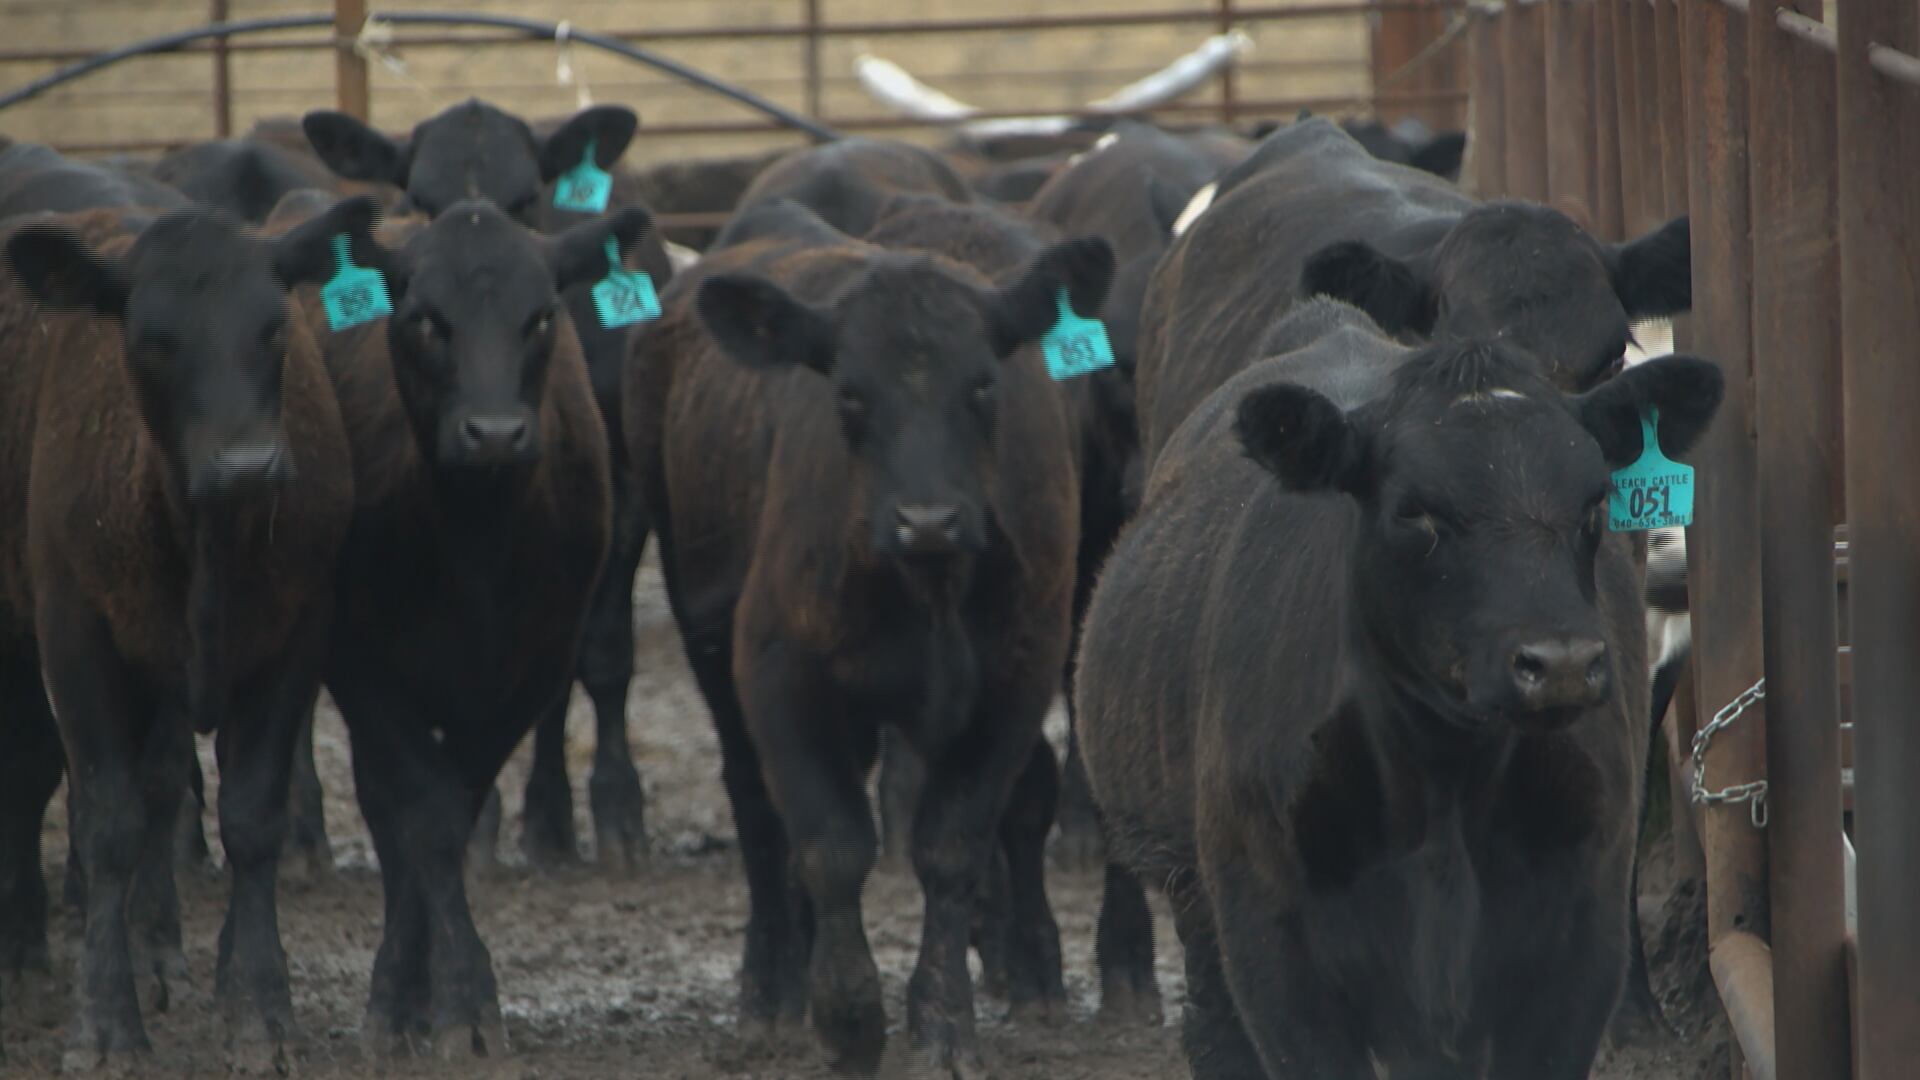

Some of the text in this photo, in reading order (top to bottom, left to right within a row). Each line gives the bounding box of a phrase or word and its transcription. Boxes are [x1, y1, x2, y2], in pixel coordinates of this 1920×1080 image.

[1615, 474, 1689, 489] LEACH CATTLE
[1629, 486, 1672, 518] 051
